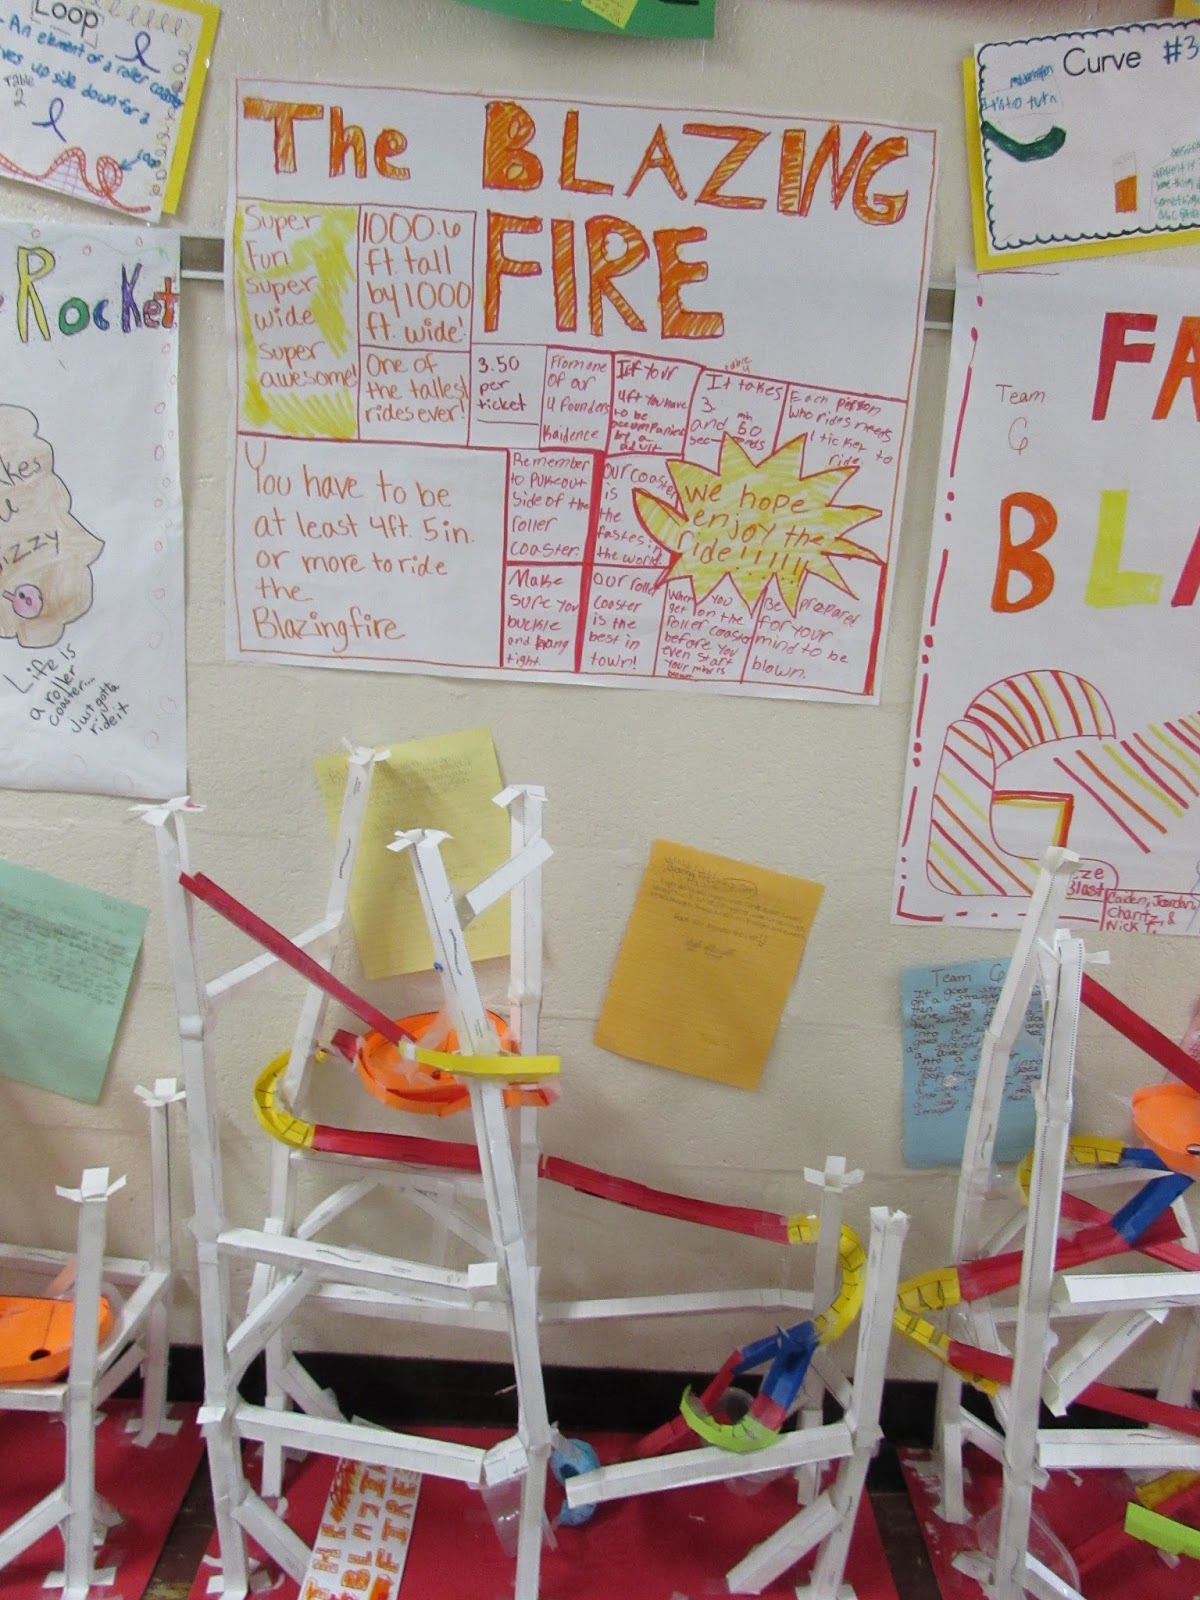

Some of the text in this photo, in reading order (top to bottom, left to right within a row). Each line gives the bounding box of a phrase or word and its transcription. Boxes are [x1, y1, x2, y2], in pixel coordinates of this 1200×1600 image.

[35, 0, 98, 37] Loop
[1063, 47, 1141, 76] Curve
[243, 96, 907, 226] The BLAZING
[245, 204, 322, 242] Super
[404, 246, 451, 276] tall
[483, 209, 724, 339] FIRE
[366, 281, 471, 319] by 1000
[254, 304, 314, 331] wide
[404, 317, 466, 344] wide!
[366, 352, 438, 376] One of
[478, 356, 520, 374] 3.50
[367, 375, 469, 400] the tallest
[479, 379, 510, 395] per
[706, 373, 783, 401] It takes
[995, 384, 1046, 404] Team
[477, 393, 526, 412] ticket
[560, 395, 610, 415] founders
[701, 396, 716, 413] 3
[690, 417, 729, 433] and
[513, 452, 591, 471] Remember
[875, 450, 893, 464] to
[245, 441, 456, 508] You have to be
[511, 472, 525, 486] to
[605, 482, 618, 500] is
[740, 484, 809, 513] hope
[545, 493, 590, 511] of the
[253, 507, 287, 537] at
[297, 511, 358, 539] least
[423, 517, 439, 540] 5
[512, 515, 558, 533] roller
[599, 507, 622, 523] the
[693, 508, 825, 548] enjoy the
[597, 546, 619, 558] the
[255, 549, 448, 577] or more to ride
[255, 576, 313, 601] the
[592, 613, 637, 630] is the
[697, 609, 716, 617] on
[720, 612, 744, 626] the
[508, 635, 530, 646] and
[625, 633, 640, 651] in
[665, 631, 712, 651] before
[755, 633, 849, 663] mind to be
[589, 653, 637, 670] town!
[661, 645, 691, 660] even
[3, 643, 76, 694] Life is
[30, 665, 76, 720] a roller
[96, 682, 120, 712] gotta
[1106, 920, 1138, 932] Nick
[931, 968, 972, 987] Team
